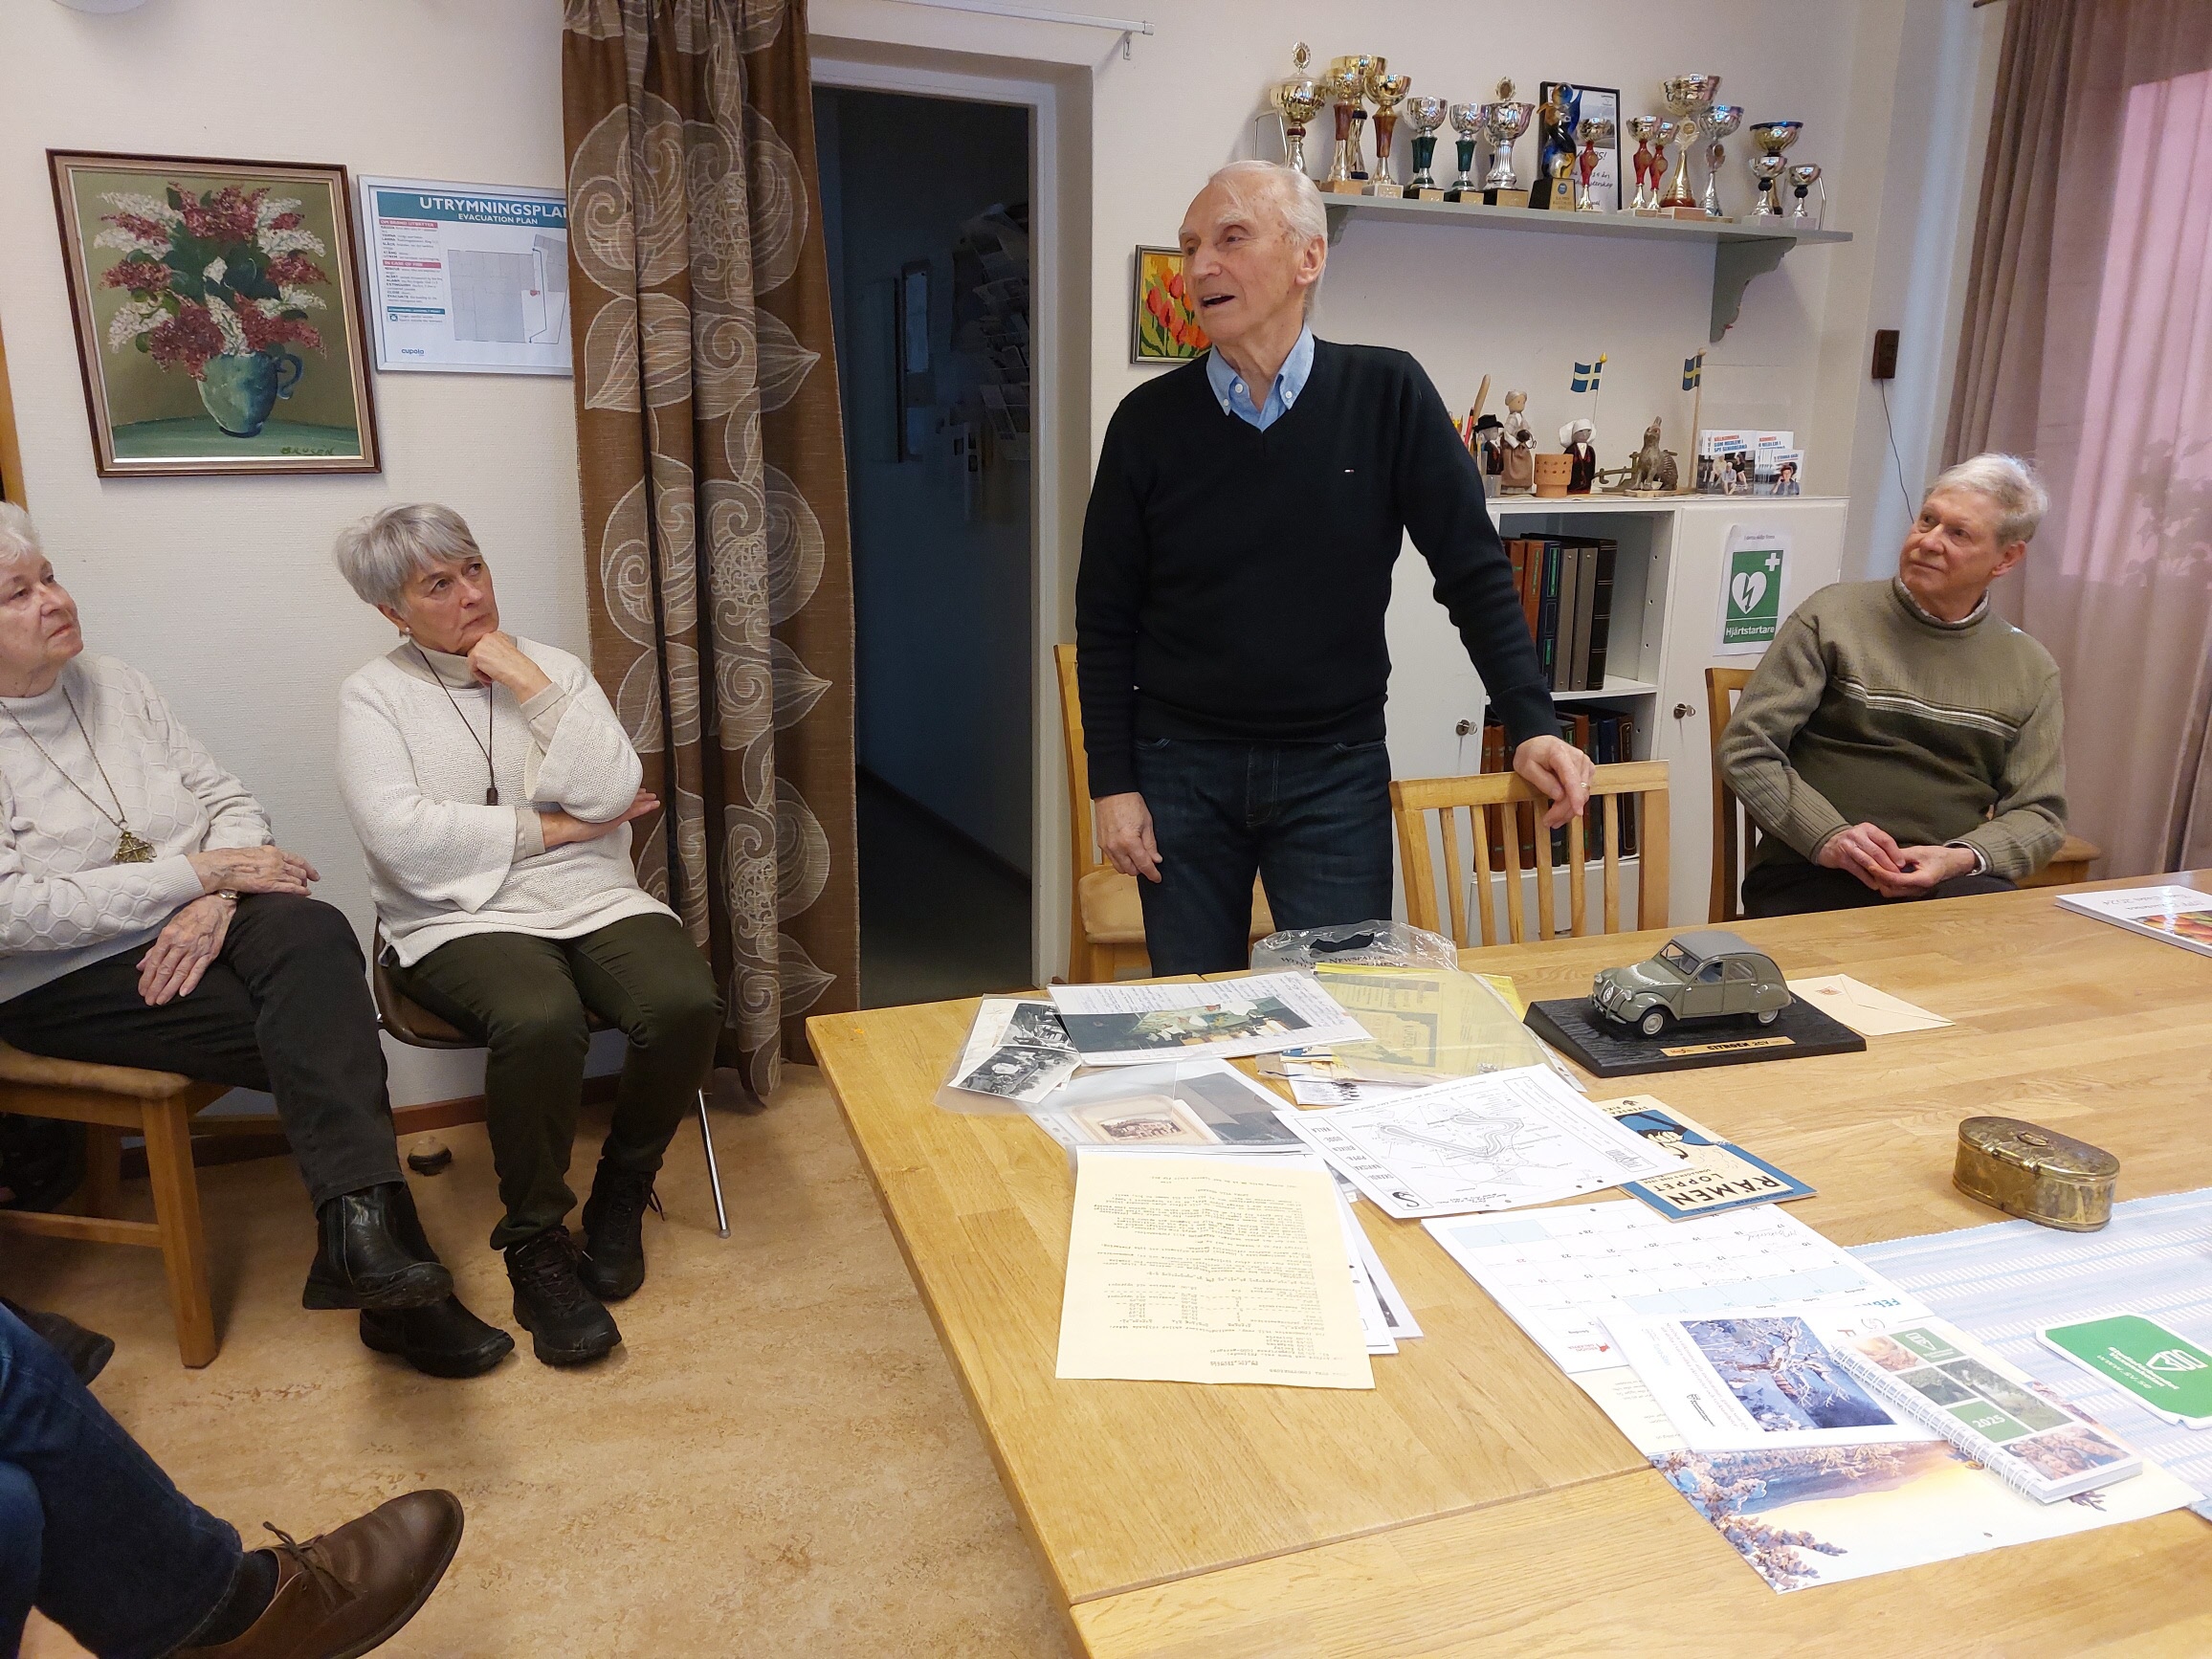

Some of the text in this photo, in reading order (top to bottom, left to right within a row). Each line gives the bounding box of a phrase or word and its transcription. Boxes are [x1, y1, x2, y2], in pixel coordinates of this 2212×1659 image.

[419, 196, 566, 219] UTRYMNINGSPLA
[458, 212, 539, 226] EVACUATION PLAN
[401, 347, 425, 357] cupola
[1725, 625, 1775, 638] Hjärtstartare
[1329, 955, 1384, 963] NEWSPAPER
[1649, 1173, 1723, 1193] LOPPET
[1666, 1175, 1781, 1206] RÄMEN
[1972, 1414, 2005, 1428] 2025
